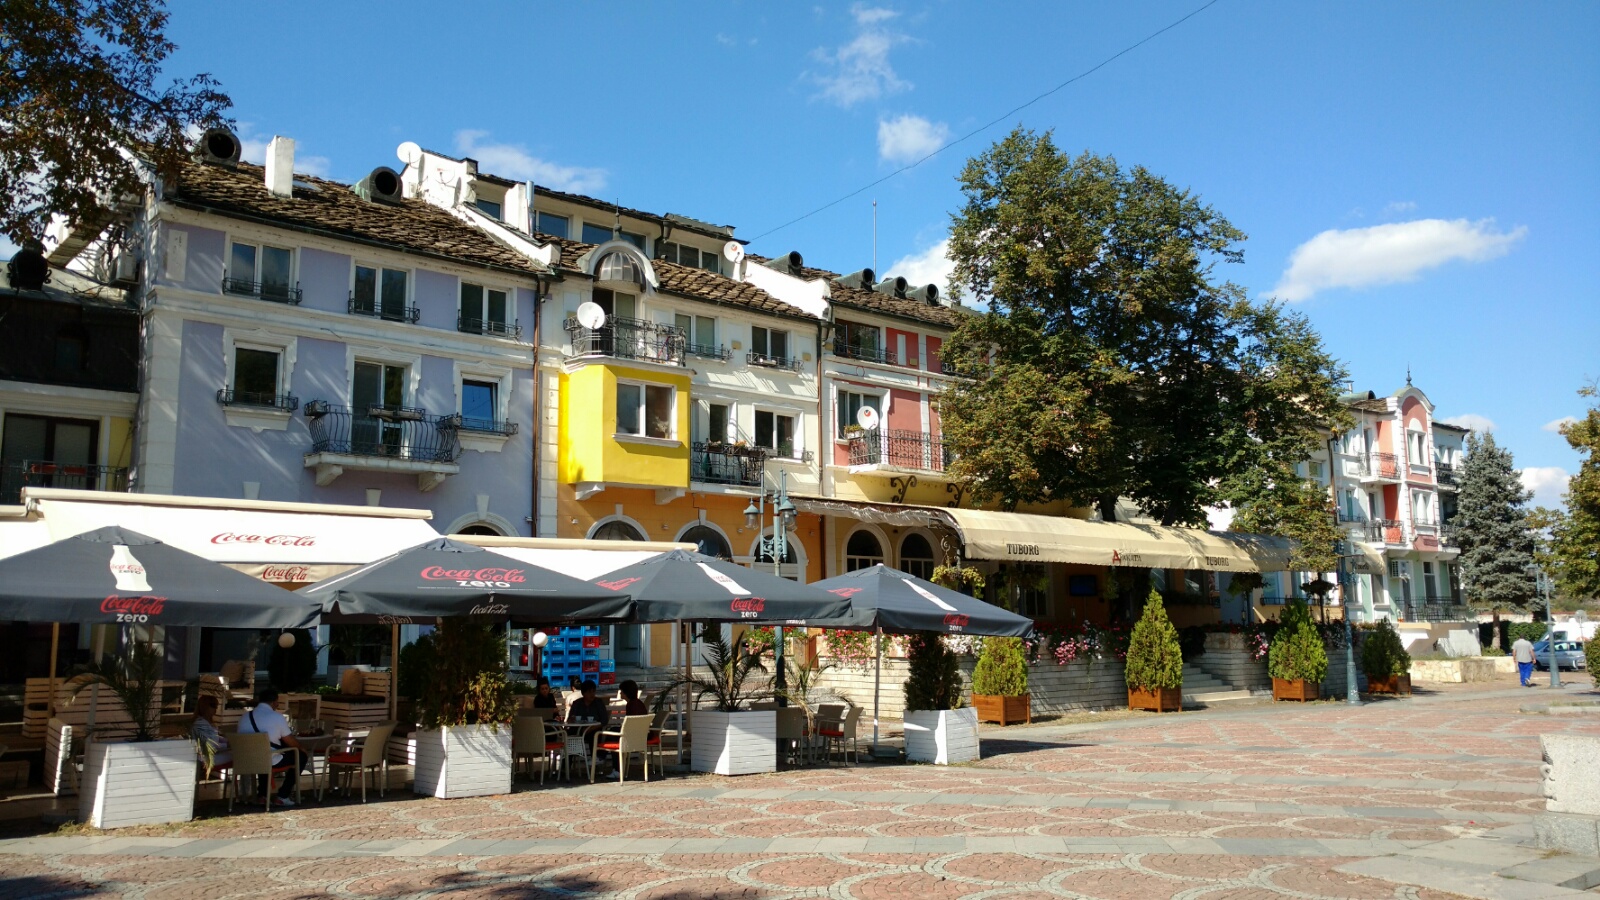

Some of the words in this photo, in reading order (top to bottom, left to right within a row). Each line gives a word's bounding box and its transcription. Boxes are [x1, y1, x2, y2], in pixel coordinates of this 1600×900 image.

[1006, 543, 1040, 556] TUBORG
[1205, 556, 1229, 567] TUBORG
[455, 580, 512, 588] zero
[116, 613, 149, 623] zero
[949, 624, 963, 632] zero
